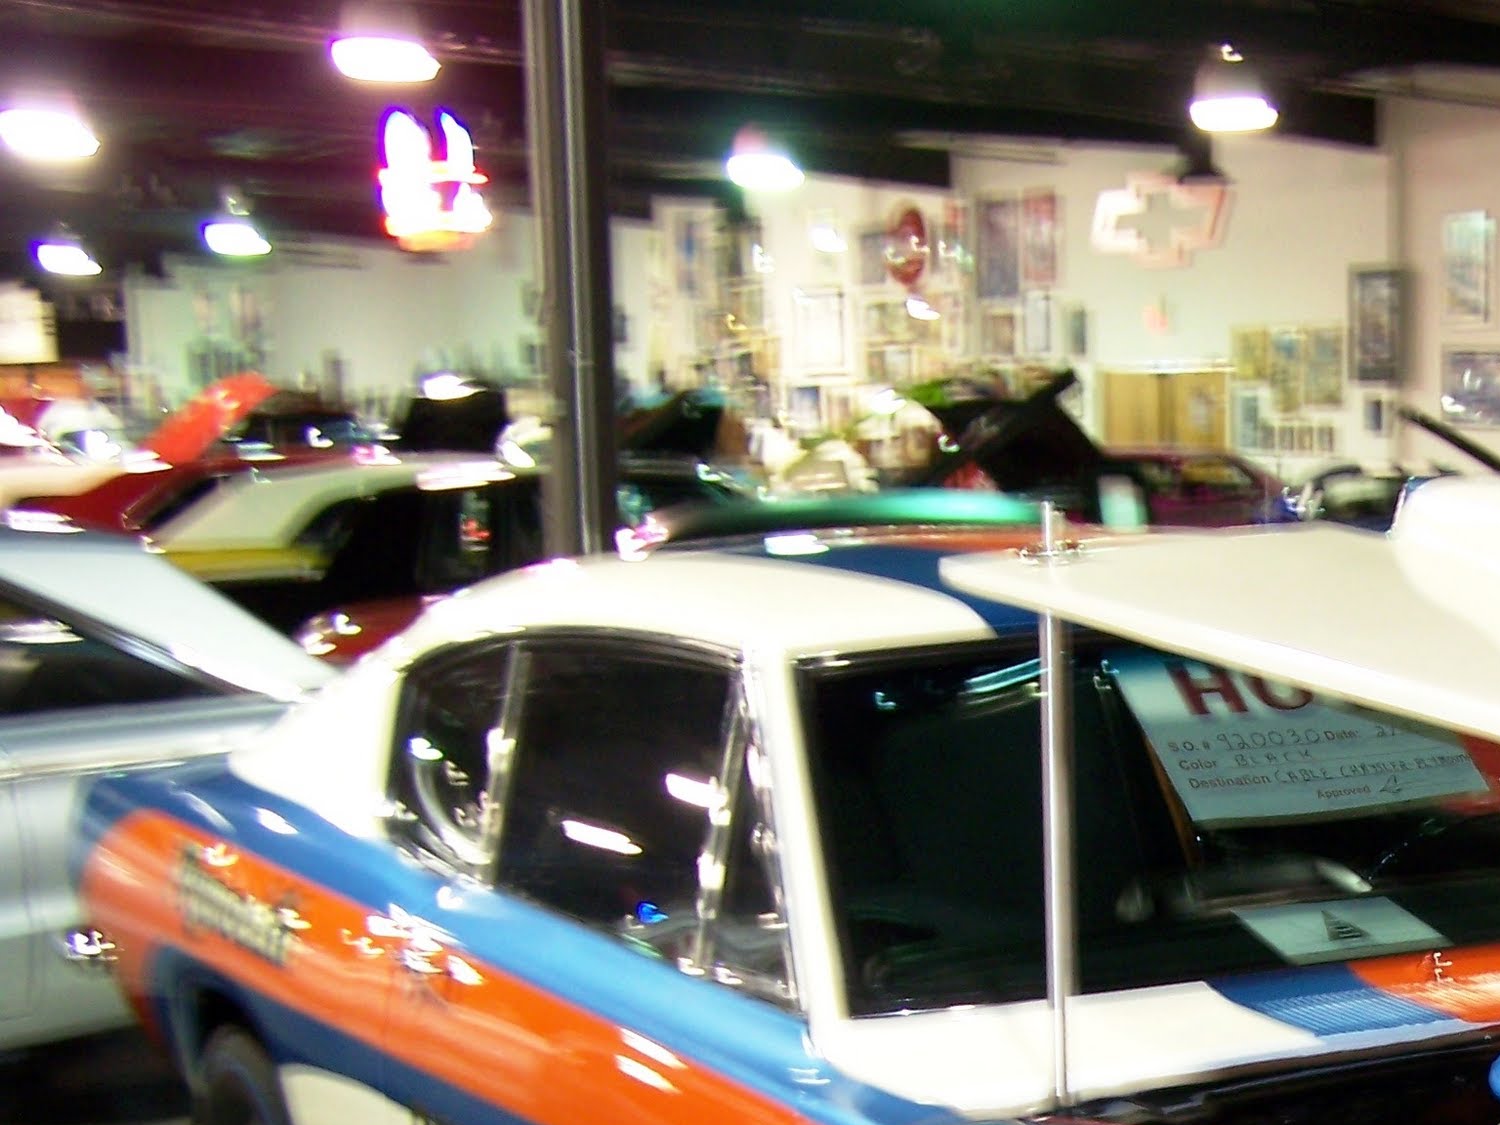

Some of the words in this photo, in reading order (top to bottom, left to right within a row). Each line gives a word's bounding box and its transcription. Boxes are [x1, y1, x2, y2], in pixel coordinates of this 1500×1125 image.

[1179, 758, 1217, 771] Color
[1235, 749, 1313, 768] BLACK
[1188, 773, 1272, 789] Destination
[1316, 785, 1372, 800] Approved
